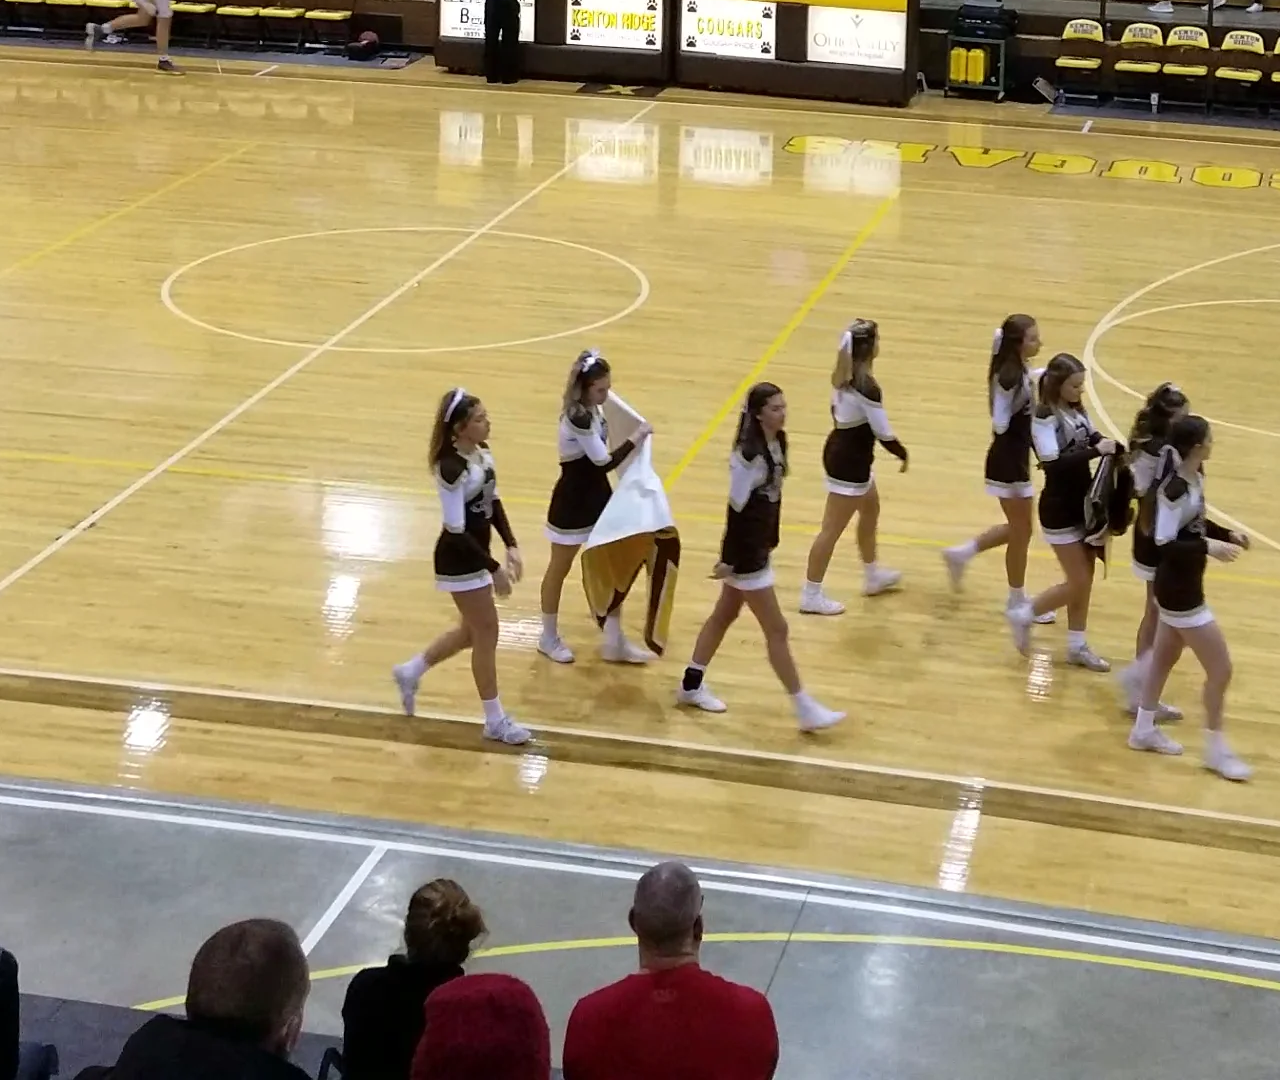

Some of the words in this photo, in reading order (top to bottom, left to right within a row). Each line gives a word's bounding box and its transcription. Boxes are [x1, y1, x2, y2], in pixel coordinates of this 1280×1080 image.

[570, 8, 618, 31] KENTON
[621, 11, 657, 33] RIDGE
[697, 17, 763, 40] COUGARS
[1229, 34, 1260, 42] KENTON
